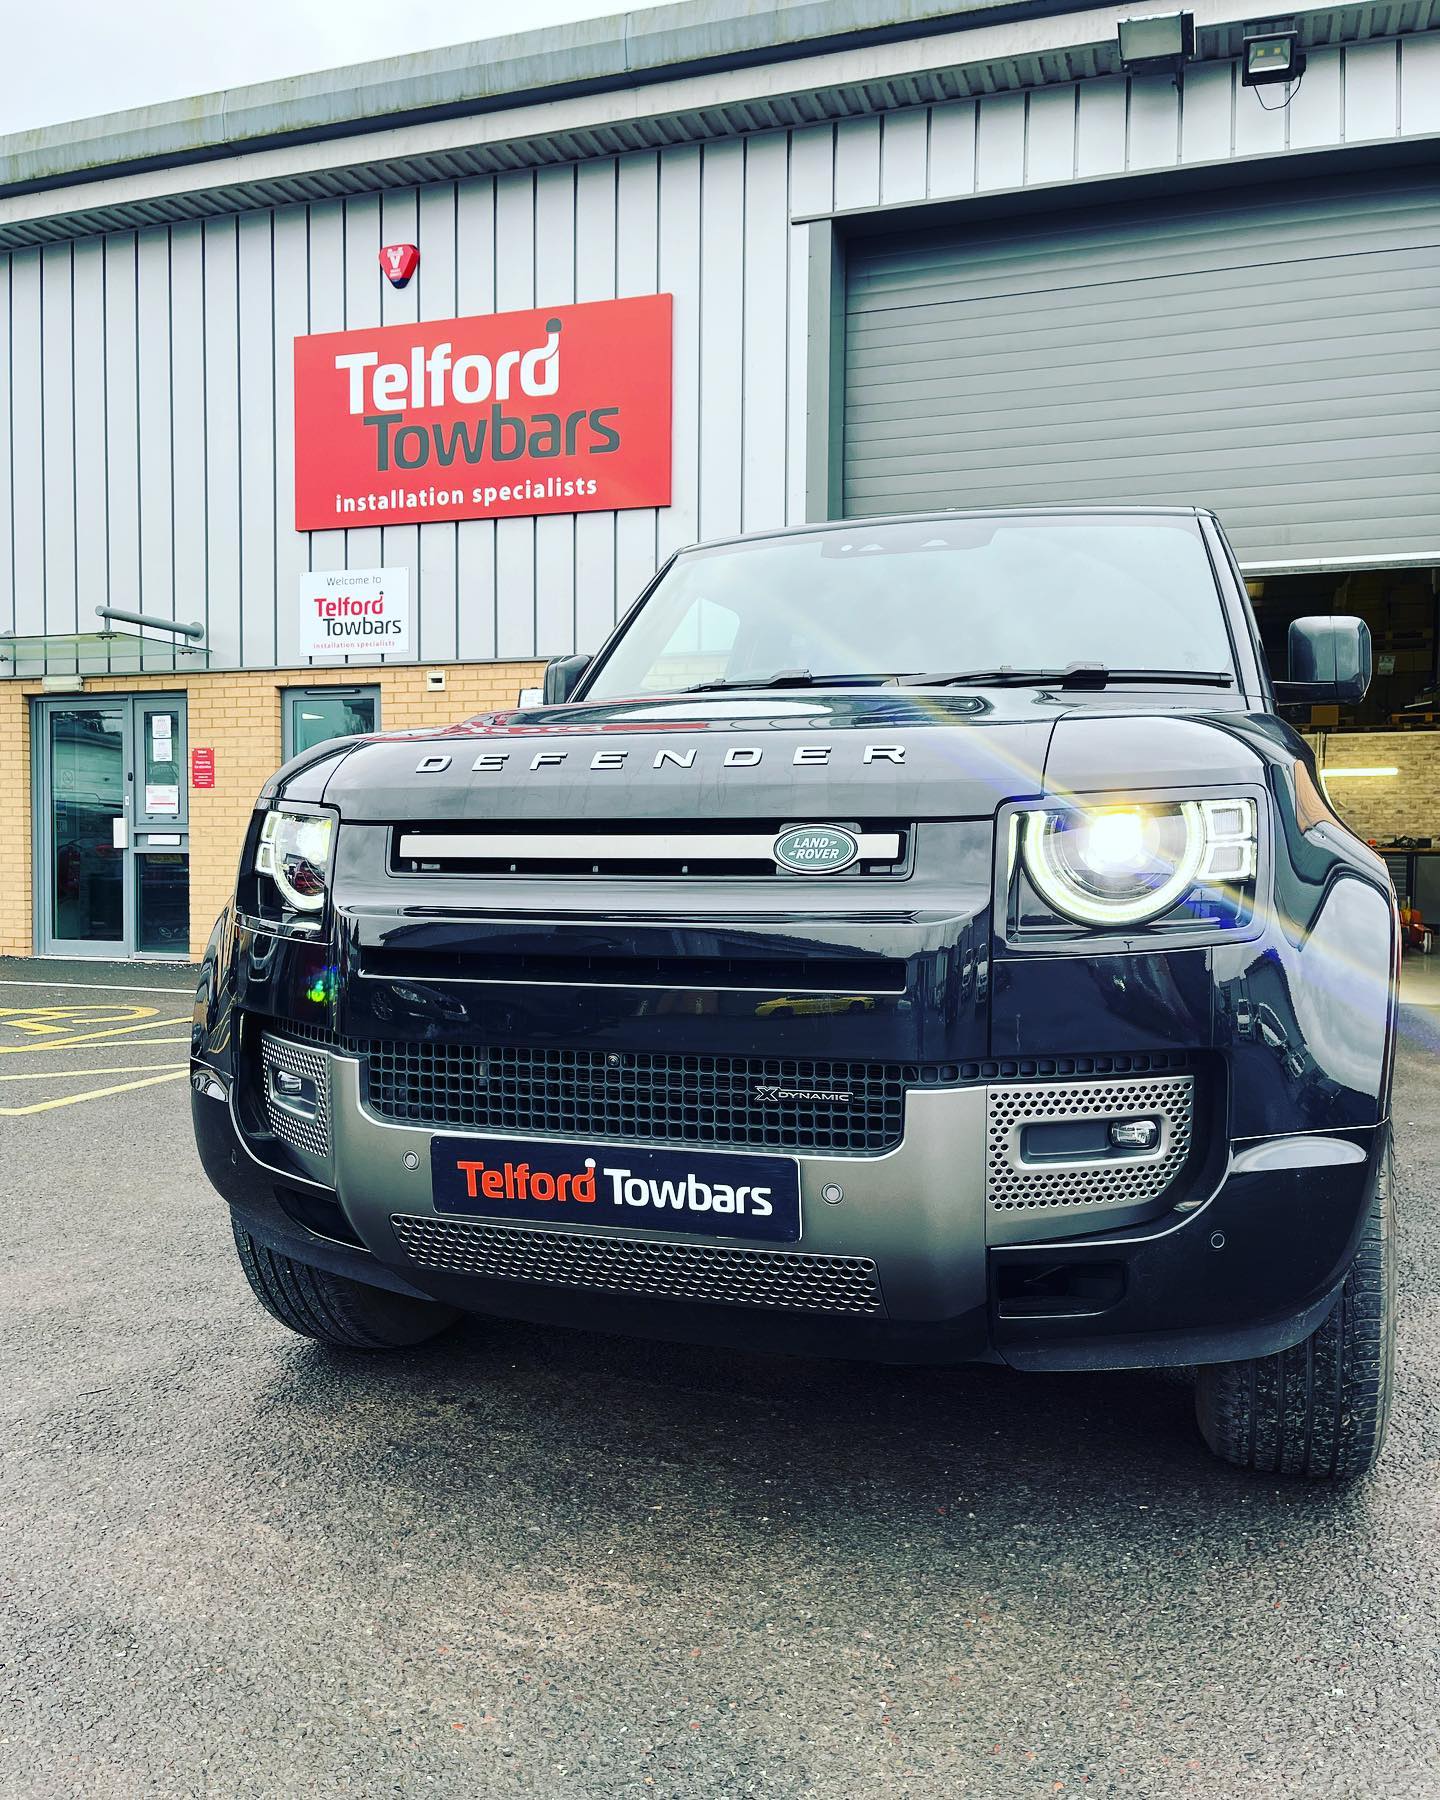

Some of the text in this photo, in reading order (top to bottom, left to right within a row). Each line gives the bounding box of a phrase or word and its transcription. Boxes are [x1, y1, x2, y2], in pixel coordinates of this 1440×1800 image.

[335, 317, 562, 414] Telford
[363, 404, 620, 471] Towbars
[336, 477, 598, 512] installation specialists
[326, 576, 382, 586] Welcome to
[314, 591, 384, 617] Telford
[323, 617, 402, 636] Towbars
[313, 640, 395, 649] installation specialists
[415, 745, 907, 773] DEFENDER
[793, 837, 829, 848] LAND
[795, 848, 840, 860] ROVER
[457, 1158, 773, 1216] Telford Towbars
